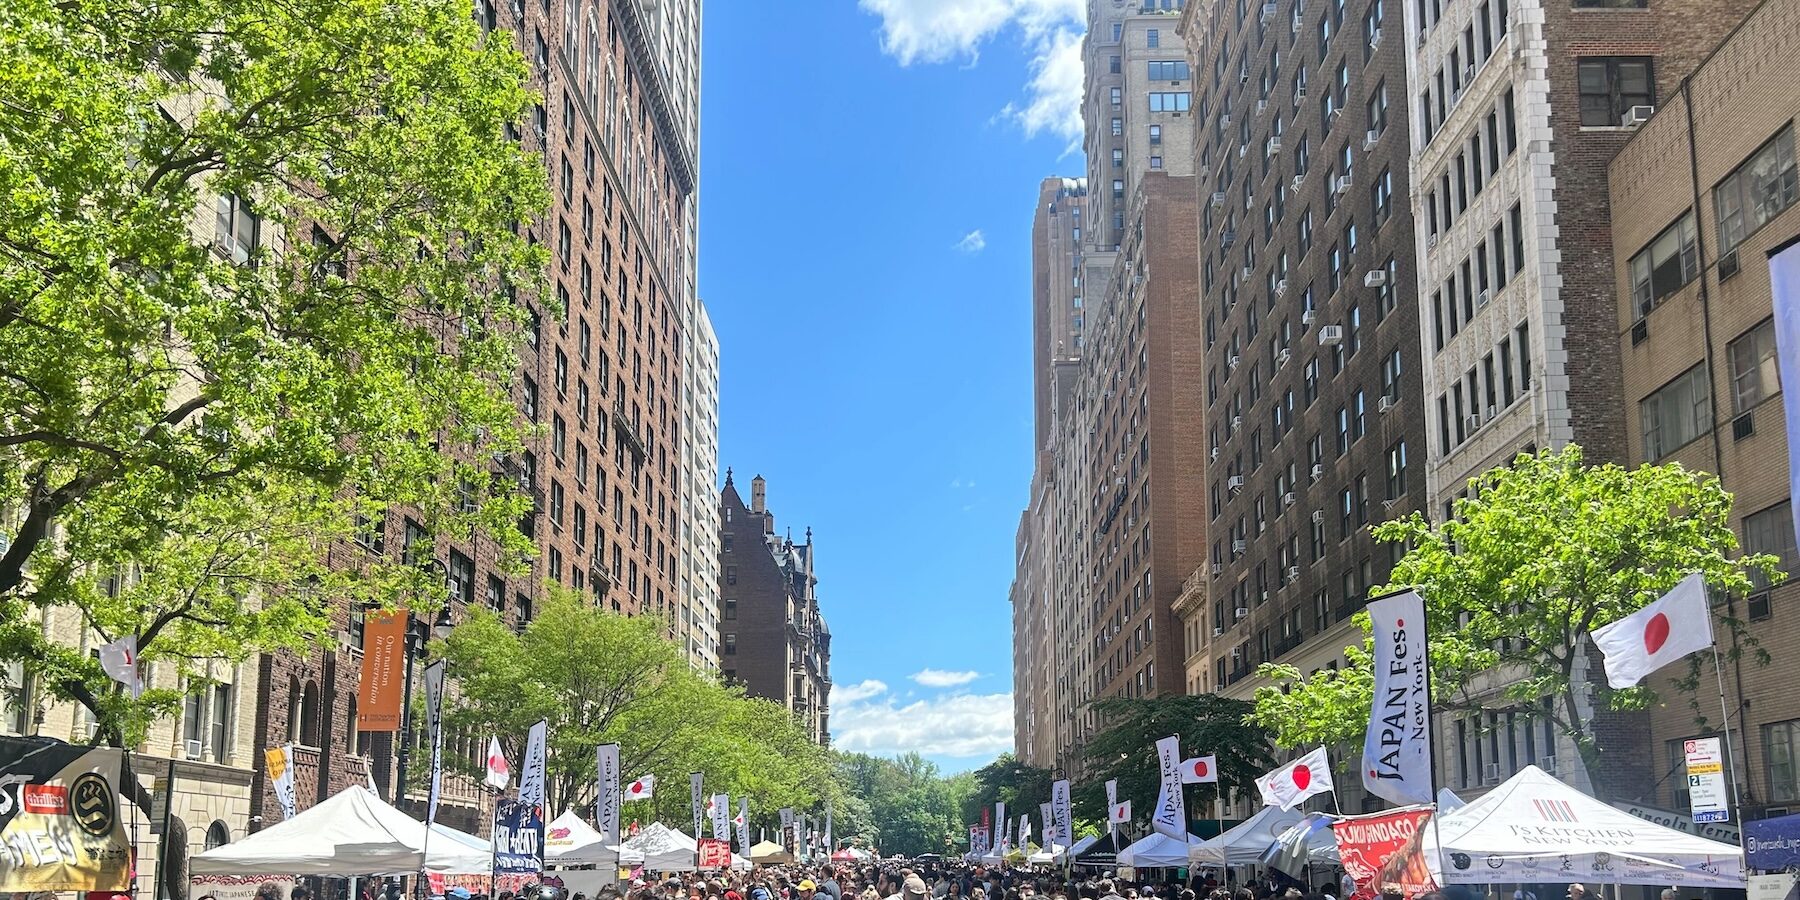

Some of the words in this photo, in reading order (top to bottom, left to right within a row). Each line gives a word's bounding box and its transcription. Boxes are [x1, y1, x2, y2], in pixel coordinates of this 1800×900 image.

[376, 635, 385, 645] in
[386, 635, 394, 653] Our
[370, 647, 382, 705] conversation
[382, 655, 391, 686] nation
[1412, 657, 1424, 694] York
[1411, 708, 1425, 741] New
[1691, 776, 1698, 786] 2
[26, 793, 64, 808] thrillist
[1522, 836, 1571, 844] NEW
[1536, 826, 1634, 838] KITCHEN
